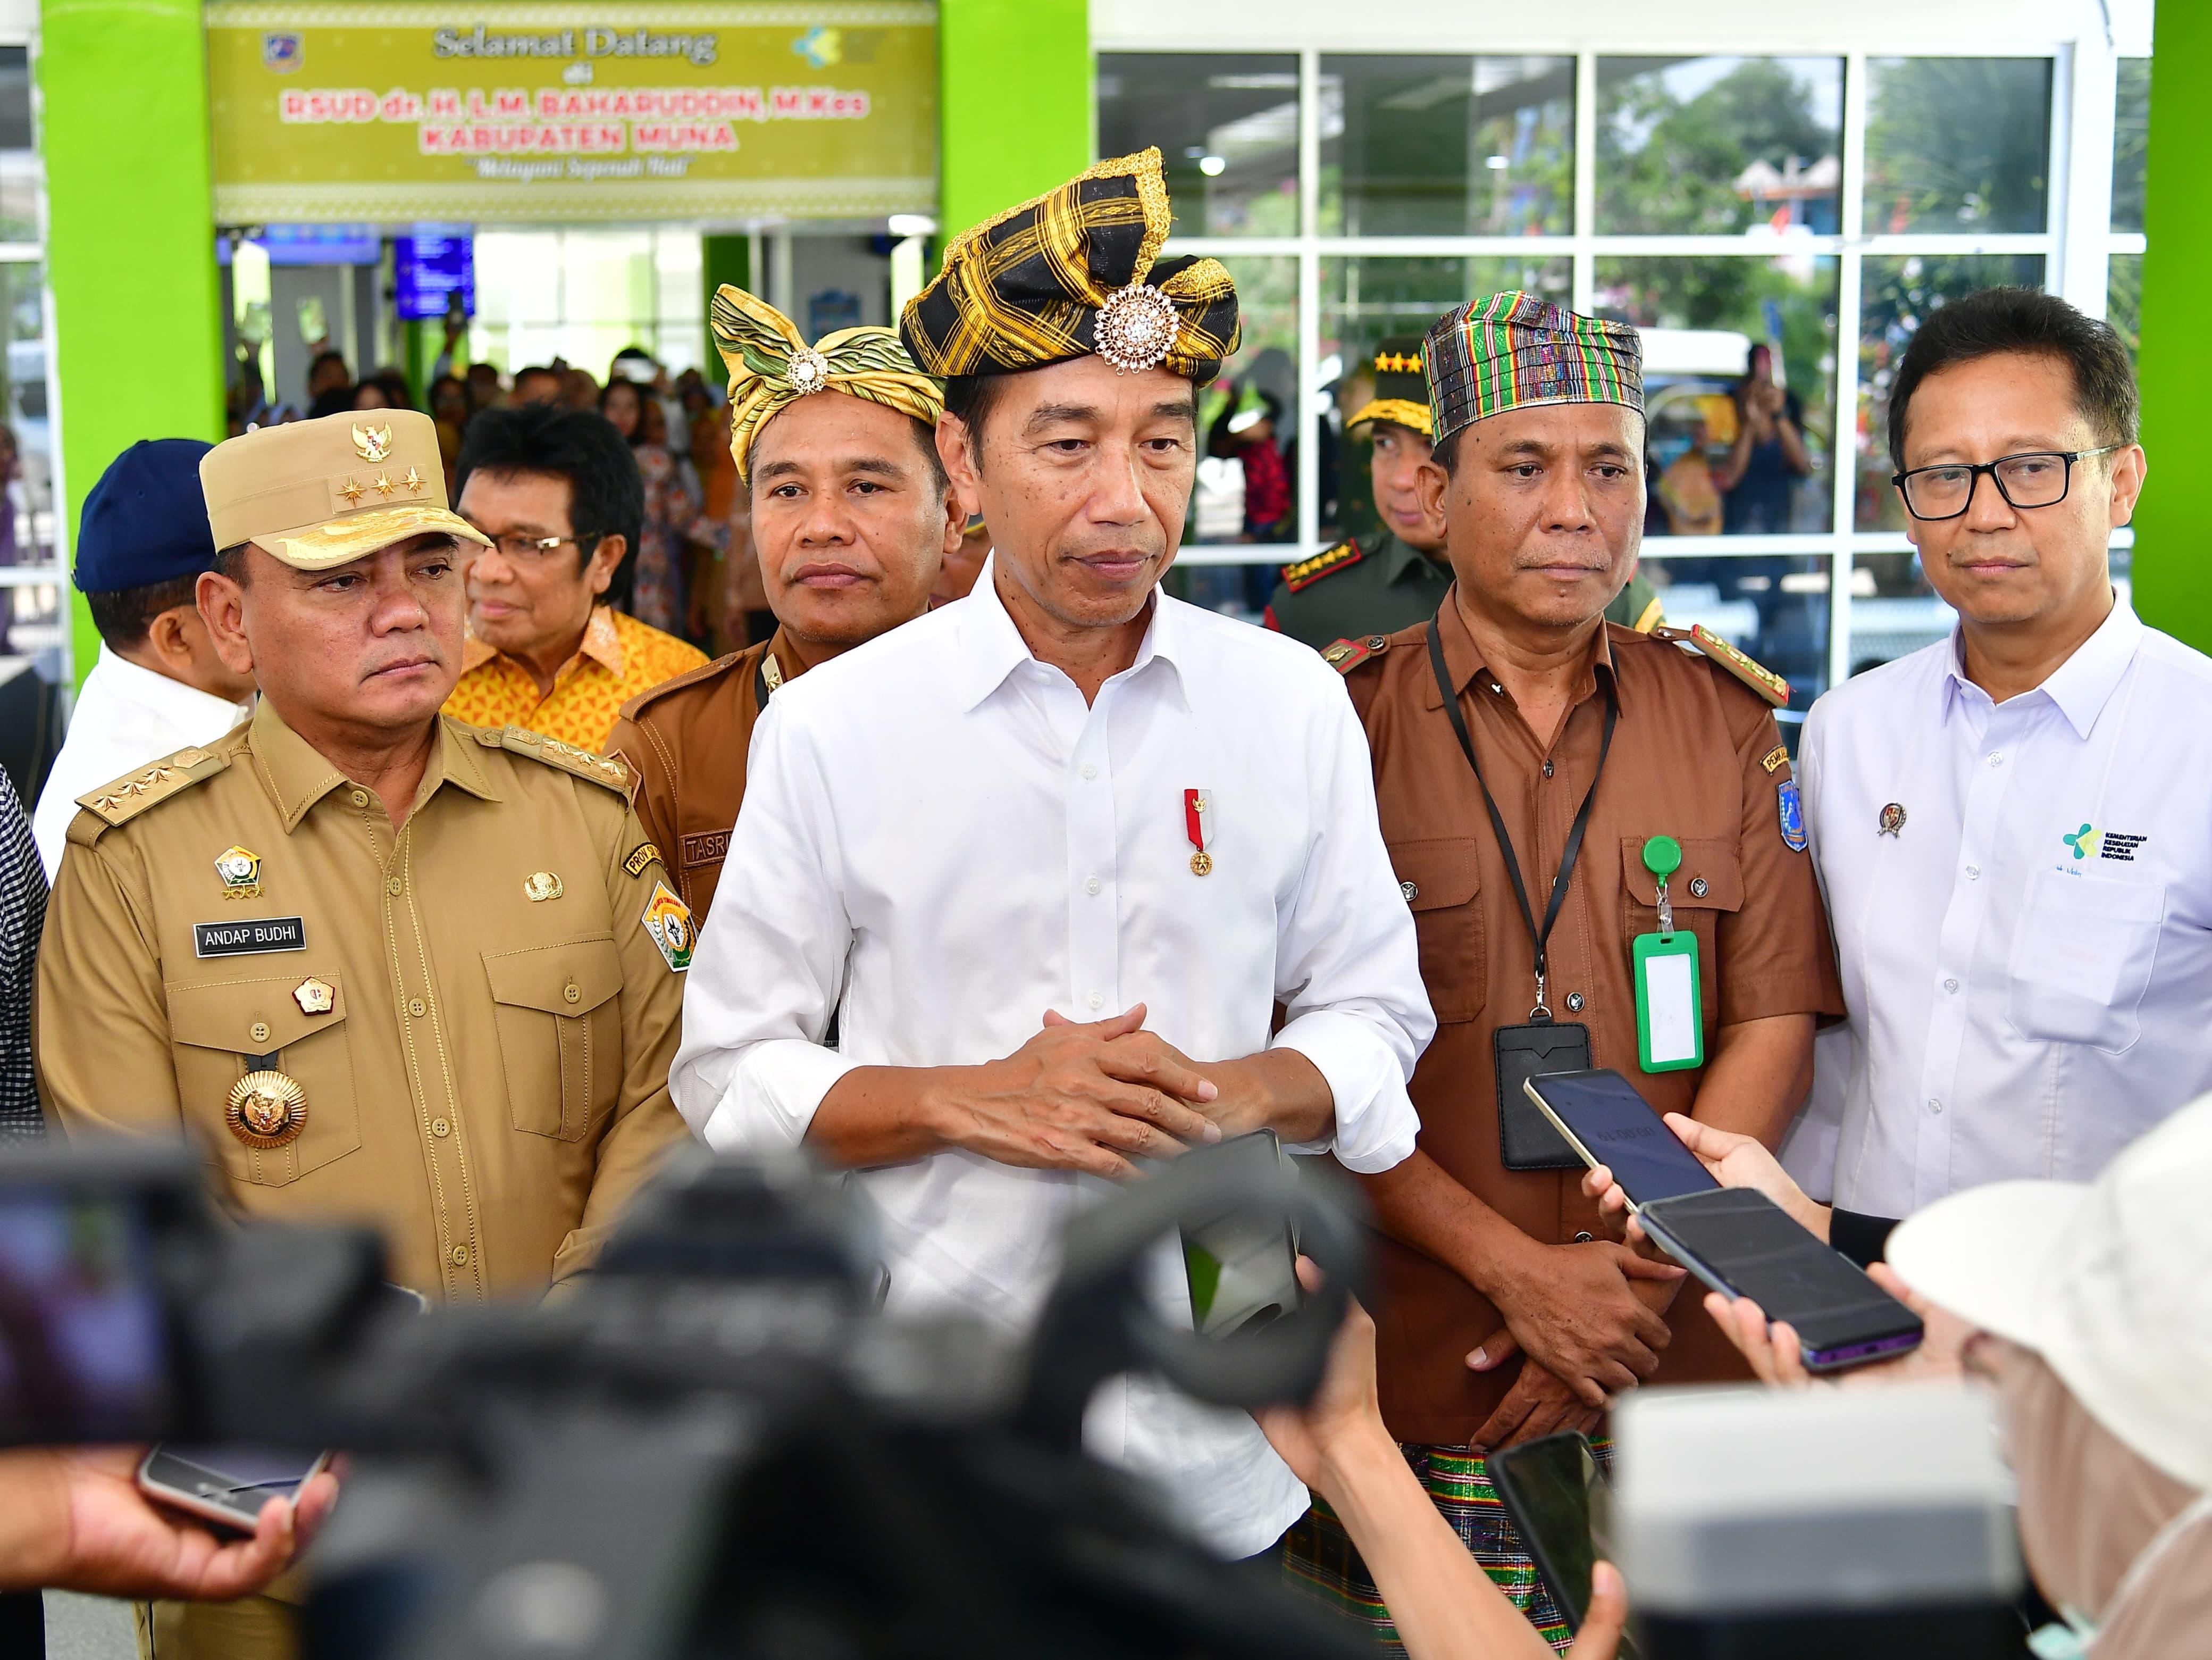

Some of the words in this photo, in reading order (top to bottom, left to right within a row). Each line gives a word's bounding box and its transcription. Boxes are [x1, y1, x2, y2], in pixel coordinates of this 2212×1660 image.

[434, 24, 575, 57] Selamat
[585, 27, 717, 65] Datang
[562, 60, 594, 84] di
[282, 89, 376, 122] RSUD
[380, 88, 424, 121] dr.
[535, 87, 768, 122] BAHARUDDIN,
[420, 123, 625, 153] KABUPATEN
[633, 122, 738, 152] MUNA
[2104, 839, 2139, 848] KESEHATAN
[2105, 832, 2147, 841] KEMENTERIAN
[629, 848, 649, 872] PROV
[2101, 852, 2134, 861] INDONESIA
[2102, 846, 2131, 854] REPUBLIK
[205, 929, 250, 946] ANDAP
[255, 925, 296, 942] BUDHI
